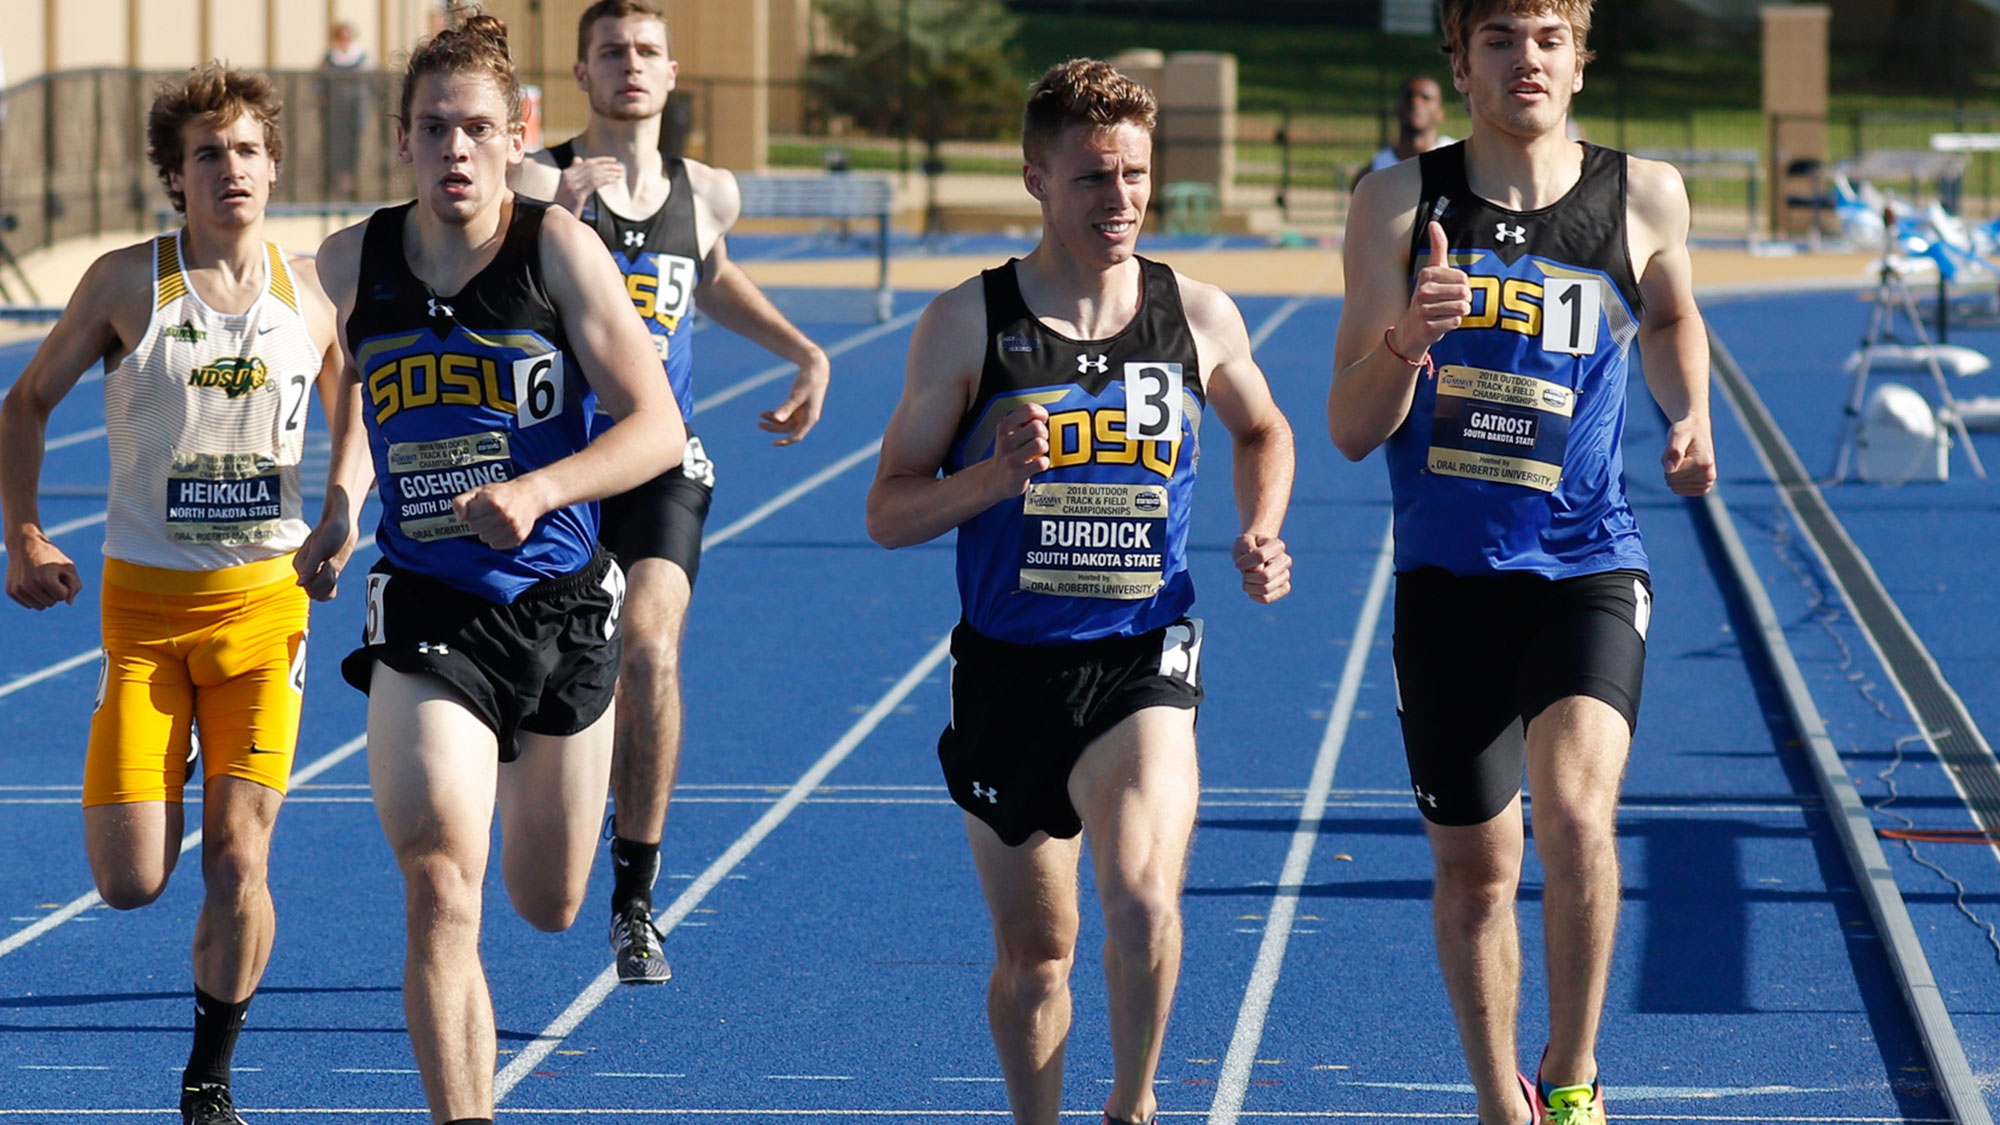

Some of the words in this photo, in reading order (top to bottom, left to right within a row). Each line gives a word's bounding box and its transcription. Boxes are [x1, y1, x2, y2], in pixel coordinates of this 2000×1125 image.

[665, 261, 686, 311] 5
[1558, 284, 1582, 349] 1
[187, 368, 250, 391] NDSU
[526, 359, 556, 420] 6
[1477, 380, 1501, 392] TRACK
[1505, 384, 1511, 393] &
[1513, 386, 1535, 397] FIELD
[1478, 371, 1498, 380] 2018
[1501, 374, 1537, 388] OUTDOOR
[285, 374, 306, 431] 2
[1139, 367, 1170, 436] 3
[1472, 389, 1538, 407] CHAMPIONSHIPS
[1470, 412, 1533, 435] GATROST
[1463, 428, 1486, 440] SOUTH
[1487, 431, 1513, 443] DAKOTA
[1515, 436, 1535, 446] STATE
[400, 463, 508, 499] GOEHRING
[1436, 460, 1457, 472] ORAL
[1459, 463, 1499, 476] ROBERTS
[1501, 467, 1551, 485] UNIVERSITY
[180, 480, 270, 504] HEIKKILA
[1066, 496, 1092, 504] TRACK
[1104, 497, 1126, 505] FIELD
[1067, 487, 1087, 496] 2018
[1089, 487, 1128, 496] OUTDOOR
[169, 507, 205, 518] NORTH
[208, 508, 247, 518] DAKOTA
[249, 505, 279, 517] STATE
[401, 499, 437, 517] SOUTH
[1062, 506, 1131, 515] CHAMPIONSHIPS
[1041, 520, 1151, 549] BURDICK
[1026, 551, 1068, 565] SOUTH
[1072, 553, 1121, 567] DAKOTA
[1124, 554, 1162, 567] STATE
[1102, 574, 1110, 582] by
[1031, 582, 1055, 592] ORAL
[1058, 583, 1100, 593] ROBERTS
[1102, 584, 1151, 595] UNIVERSITY
[1169, 620, 1196, 682] 3
